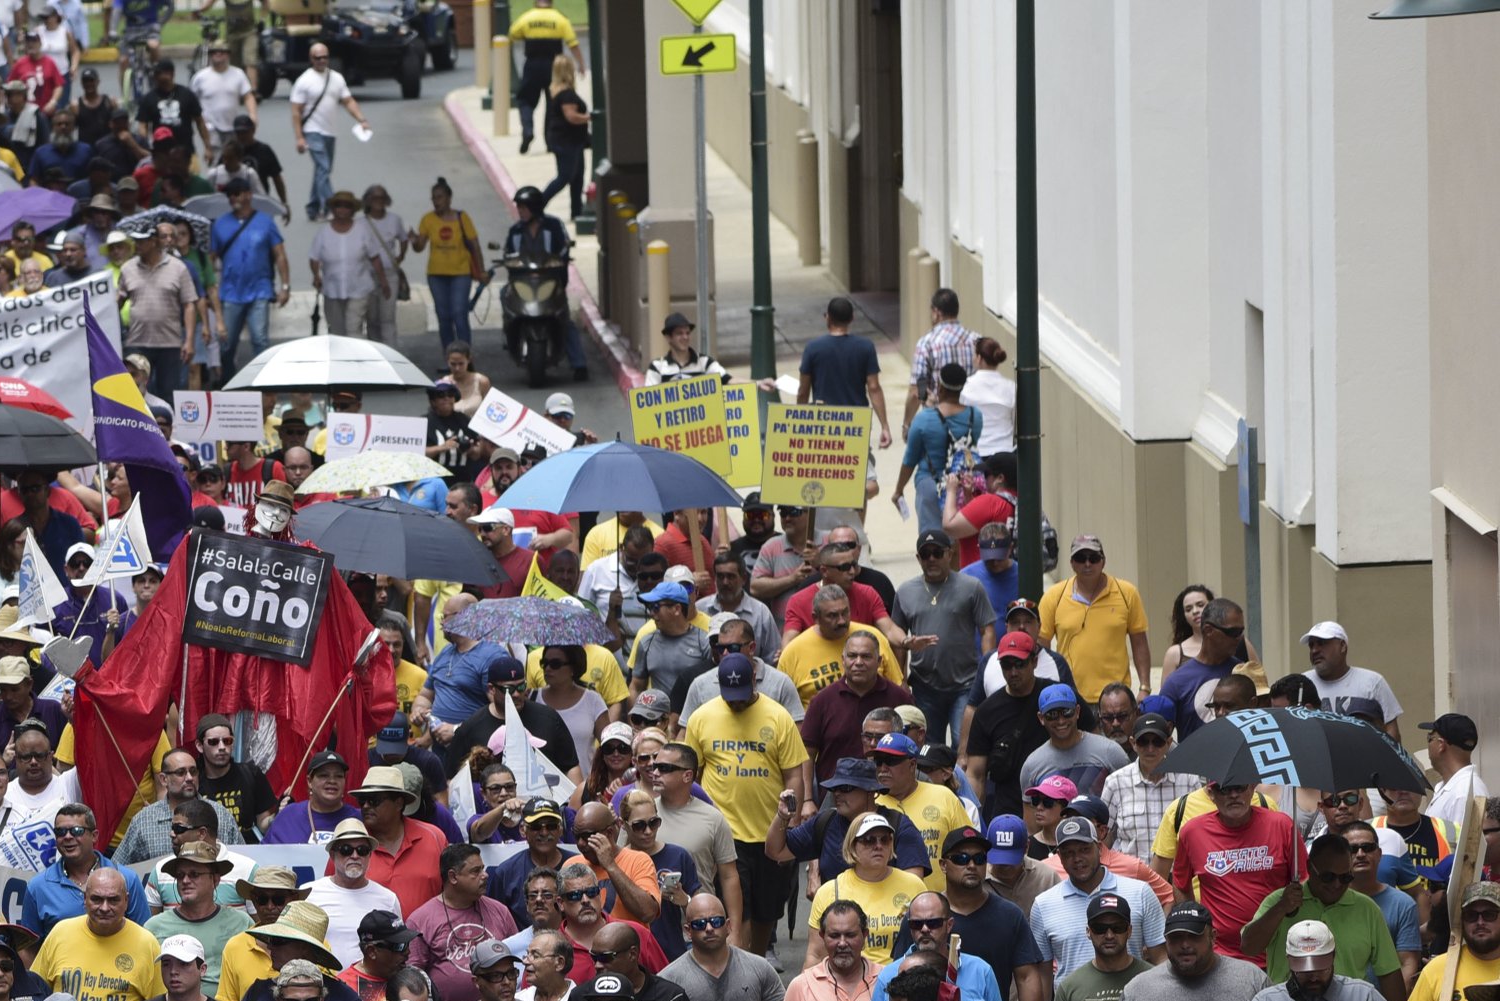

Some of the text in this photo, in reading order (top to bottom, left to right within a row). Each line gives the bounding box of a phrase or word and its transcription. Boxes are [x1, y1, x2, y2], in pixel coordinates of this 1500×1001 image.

[51, 284, 82, 303] de
[89, 279, 110, 297] la
[22, 348, 53, 368] de
[636, 390, 663, 409] CON
[682, 378, 717, 400] SALUD
[92, 415, 138, 428] SINDICATO
[654, 404, 706, 430] Y RETIRO
[785, 409, 854, 422] PARA ECHAR
[664, 424, 725, 452] SE JUEGA
[773, 423, 864, 437] PA' LANTE LA AEE
[370, 434, 424, 449] ¡PRESENTE!
[789, 438, 846, 451] NO TIENEN
[772, 452, 861, 466] QUE QUITARNOS
[774, 466, 856, 481] LOS DERECHOS
[201, 548, 317, 586] #SalalaCalle
[194, 570, 310, 629] Coño
[195, 619, 296, 648] #NoalaReformaLaboral
[809, 660, 842, 680] SER
[712, 740, 766, 753] FIRMES
[736, 753, 746, 764] Y
[716, 765, 769, 778] Pa' lante
[1207, 845, 1269, 865] PUERTO
[1234, 855, 1274, 874] RICO
[84, 971, 131, 994] Hay Derechos
